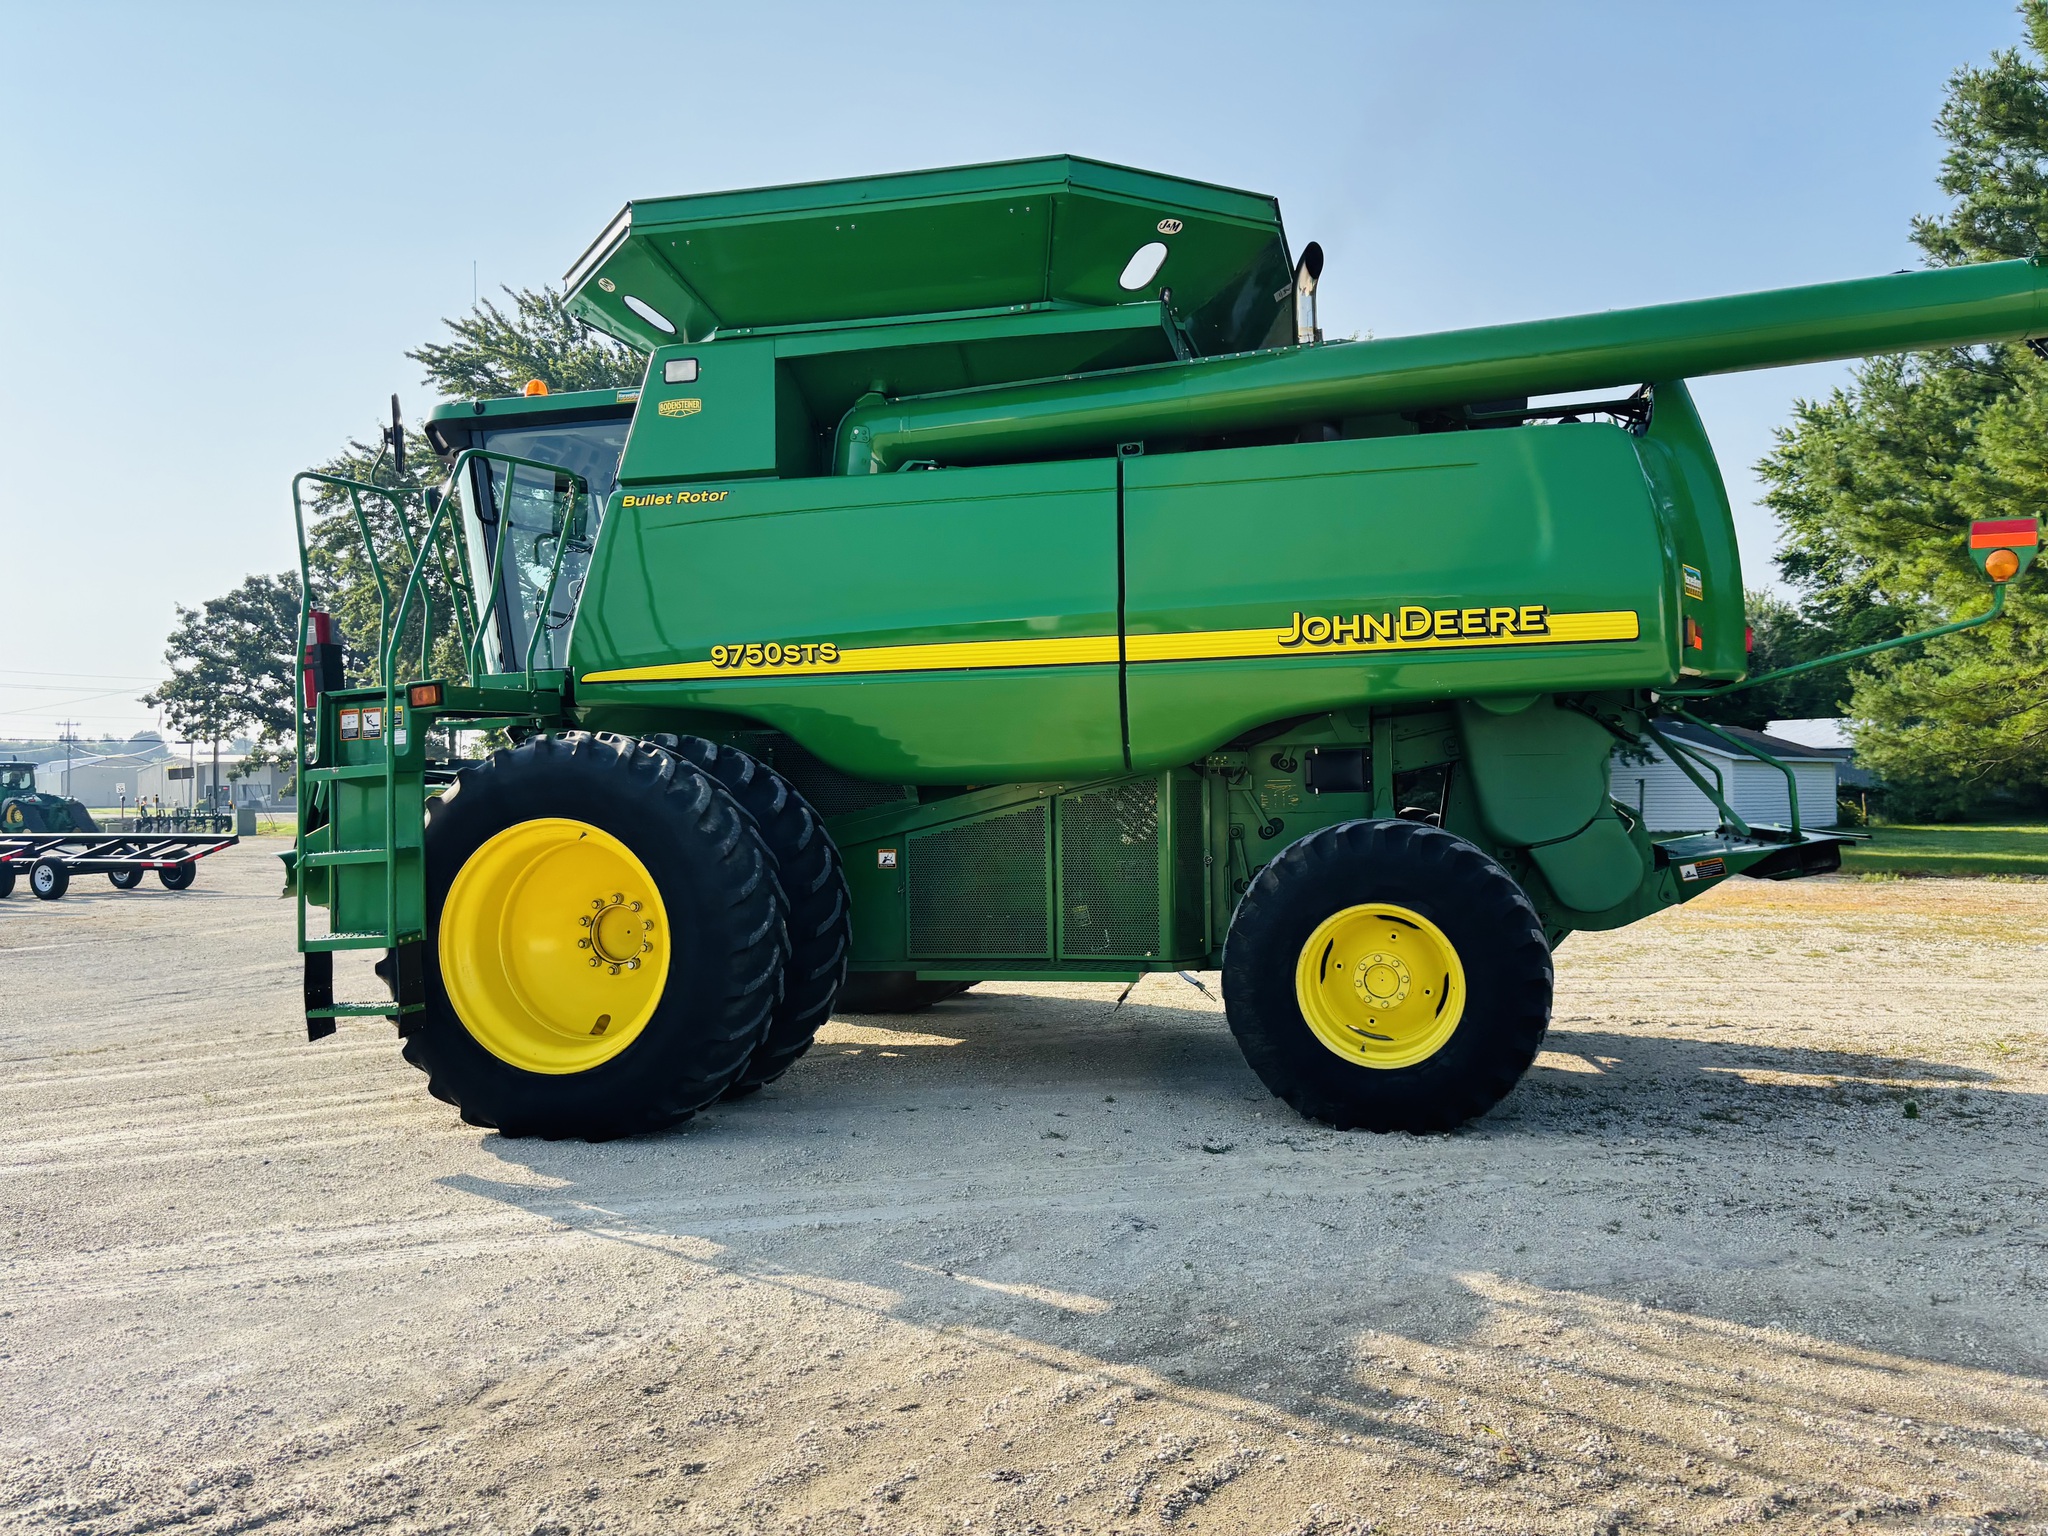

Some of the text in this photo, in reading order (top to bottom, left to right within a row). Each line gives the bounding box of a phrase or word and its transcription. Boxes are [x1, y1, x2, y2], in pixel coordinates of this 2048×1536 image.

[1158, 220, 1181, 232] J&M
[659, 400, 700, 412] BODENSTEINER
[622, 490, 729, 508] Bullet Rotor
[710, 641, 840, 670] 9750STS
